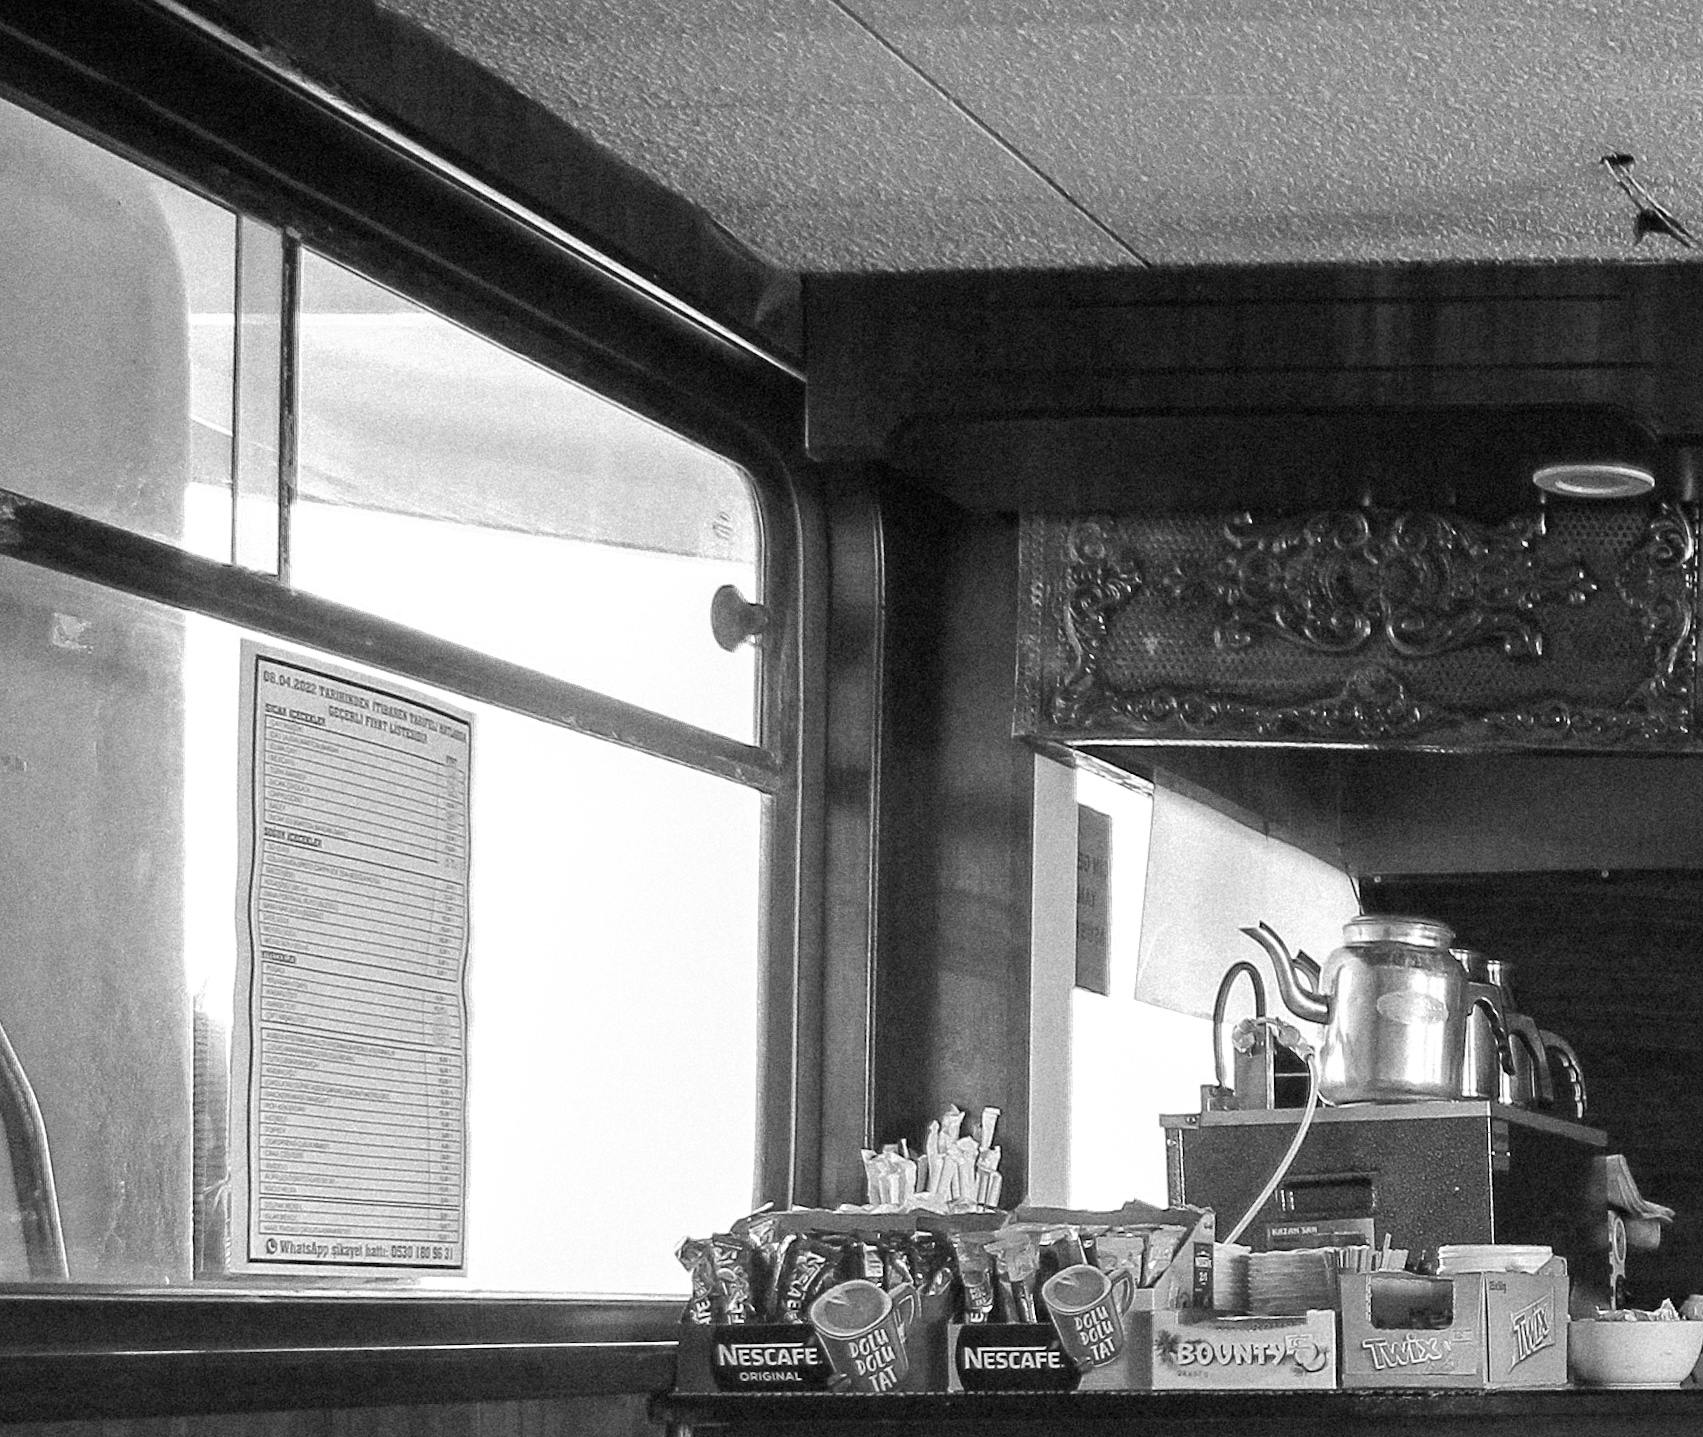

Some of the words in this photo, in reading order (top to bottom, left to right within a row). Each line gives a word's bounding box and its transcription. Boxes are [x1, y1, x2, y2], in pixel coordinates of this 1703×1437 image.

[1074, 1305, 1110, 1331] DOLU
[849, 1328, 890, 1359] DOLU
[1080, 1320, 1115, 1346] DOLU
[855, 1346, 896, 1376] DOLU
[1090, 1337, 1116, 1361] TAT
[1176, 1342, 1287, 1367] BOUNTY
[739, 1371, 803, 1382] ORIGINAL
[869, 1368, 898, 1393] TAT
